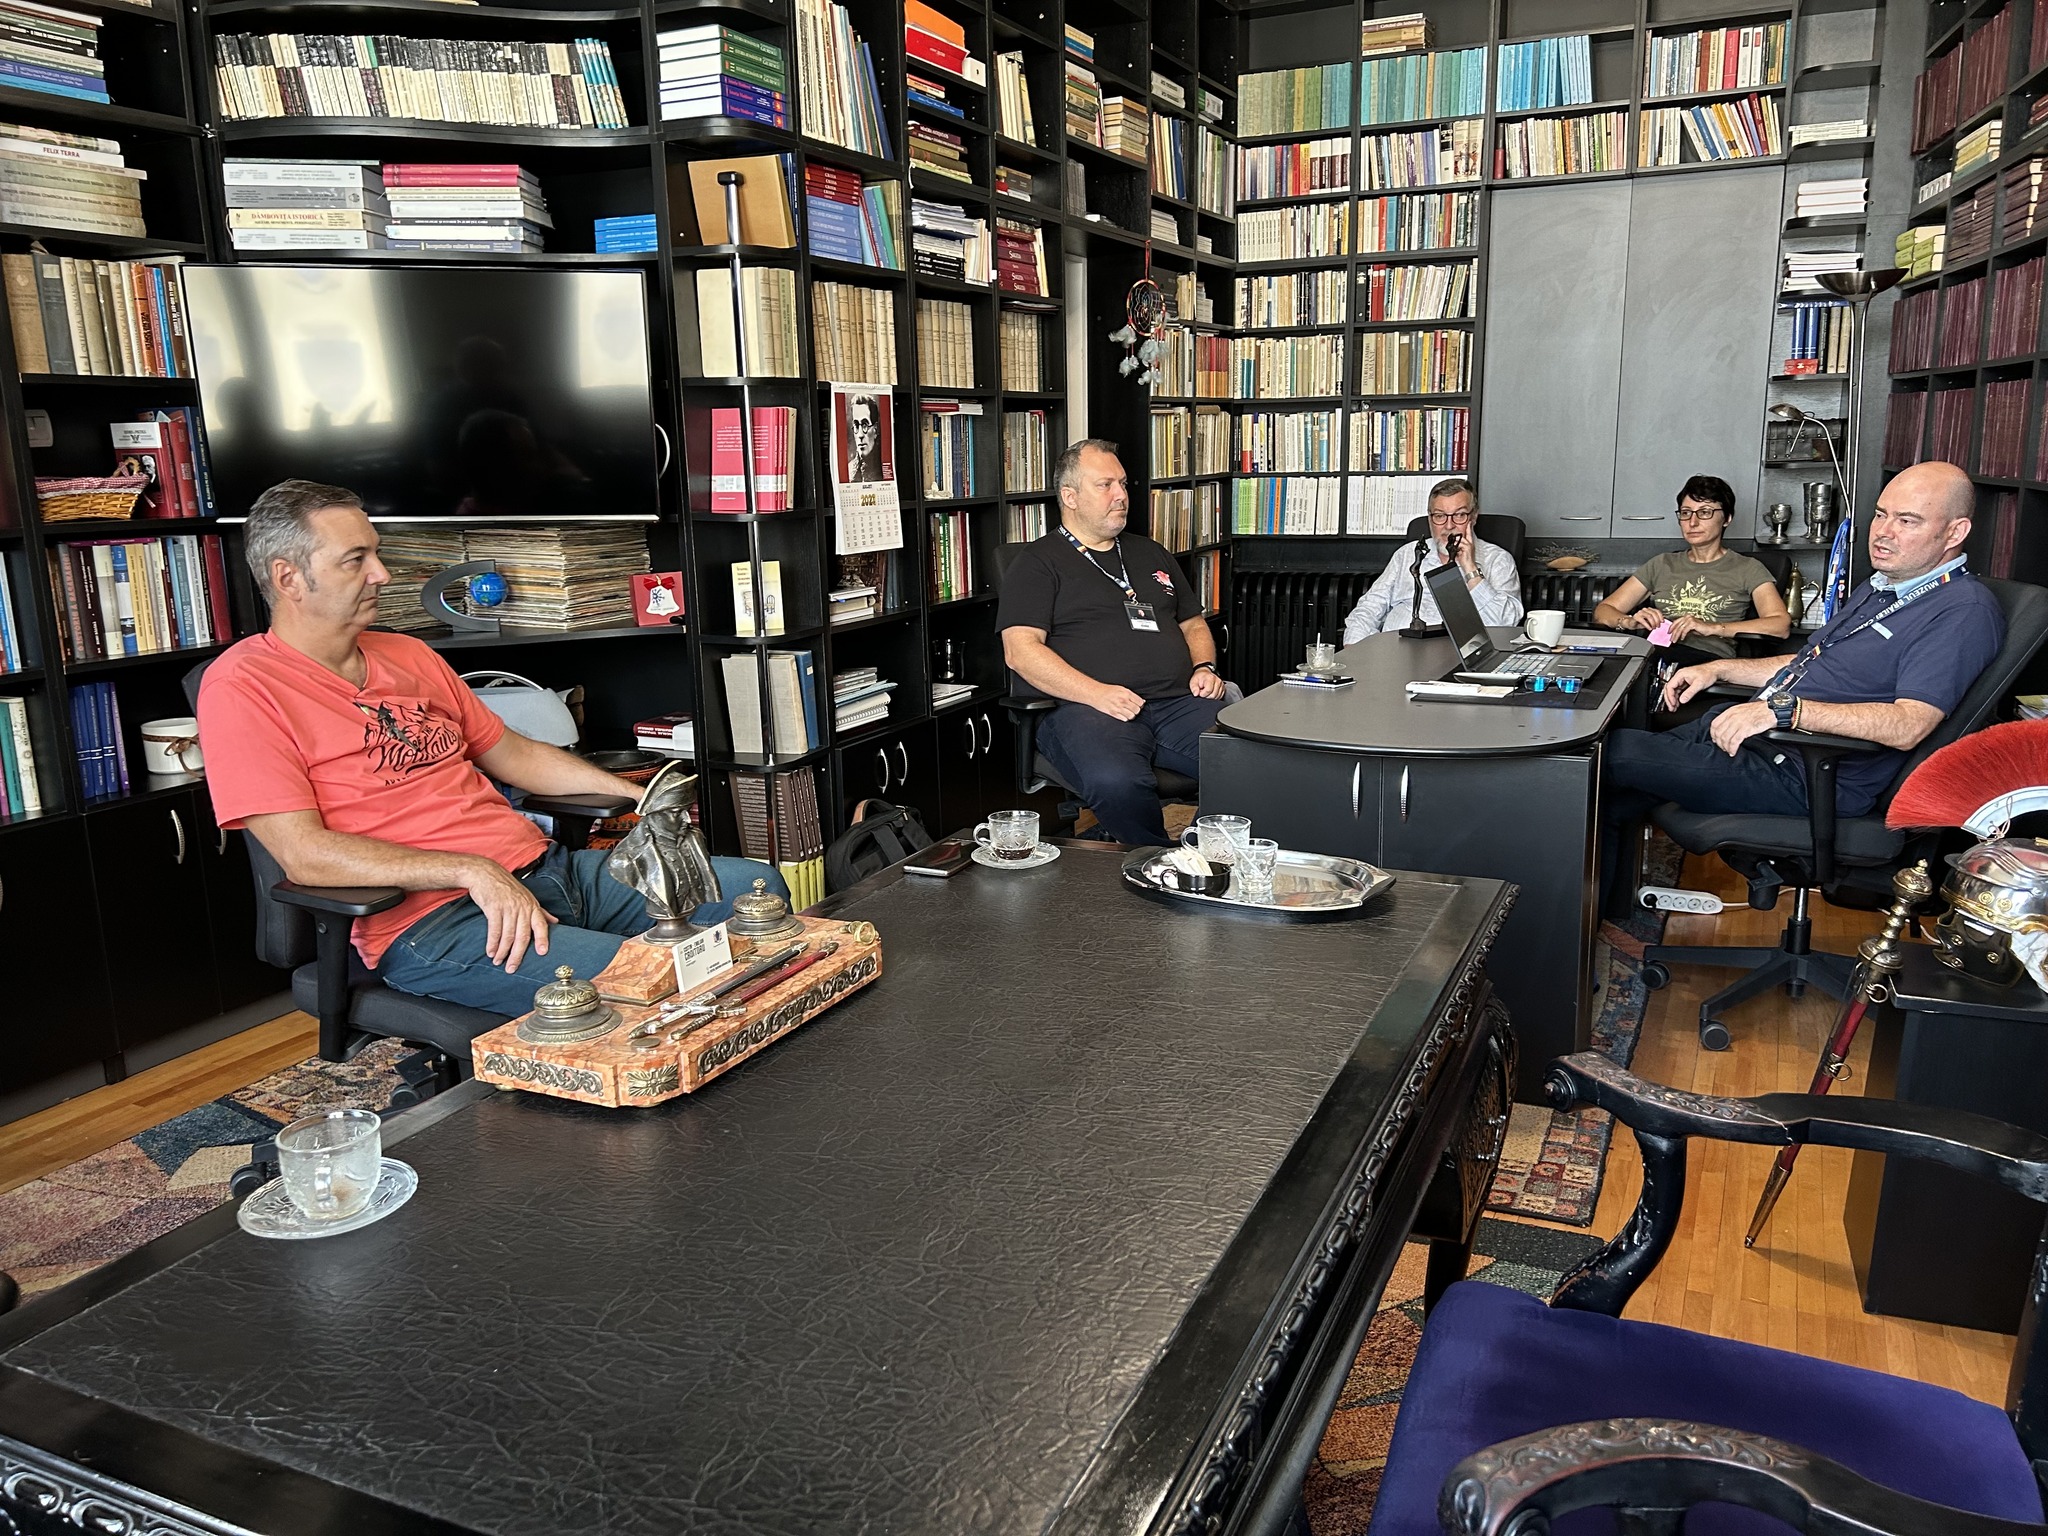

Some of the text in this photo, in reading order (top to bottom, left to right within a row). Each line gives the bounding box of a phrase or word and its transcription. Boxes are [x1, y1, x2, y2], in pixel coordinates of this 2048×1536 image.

[43, 147, 80, 158] FELIX TERRA
[62, 552, 76, 602] BASARABIEI
[1903, 580, 1940, 601] MUZEUL
[72, 613, 83, 645] ISTORIE
[684, 943, 706, 961] CROITORU
